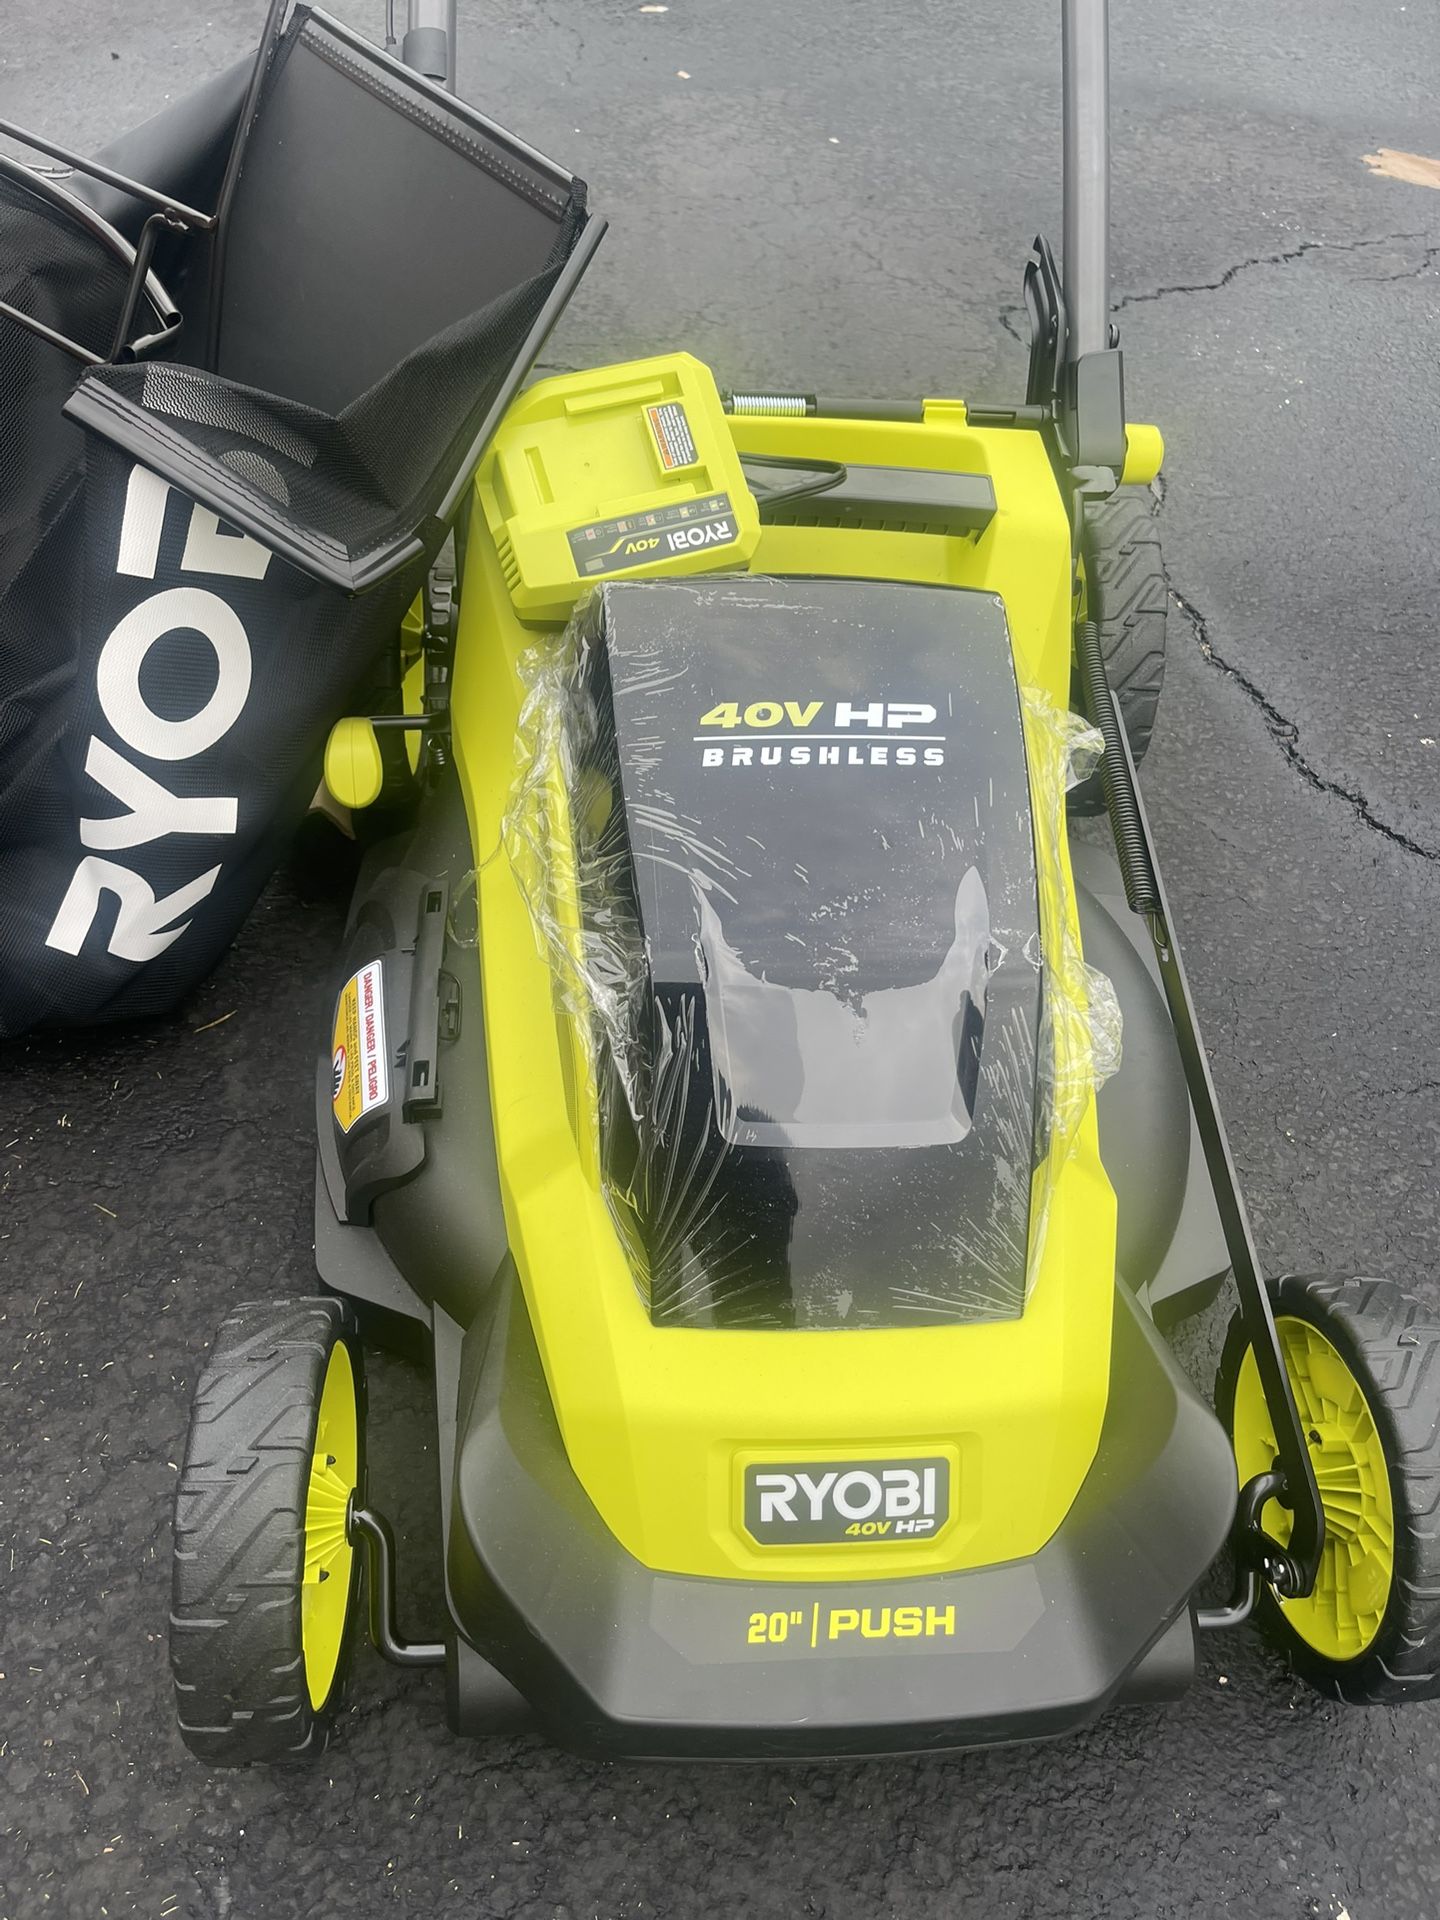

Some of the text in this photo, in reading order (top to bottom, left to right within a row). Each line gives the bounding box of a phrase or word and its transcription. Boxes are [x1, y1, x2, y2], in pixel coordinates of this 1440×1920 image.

[625, 521, 732, 555] RYOBI 40V
[700, 702, 937, 728] 40V HP
[702, 746, 945, 767] BRUSHLESS
[363, 972, 374, 1009] DANGER
[365, 1013, 376, 1053] DANGER
[367, 1059, 378, 1101] PELIGRO
[756, 1467, 936, 1522] RYOBI
[845, 1519, 935, 1536] 40V HP
[747, 1605, 956, 1644] 20" PUSH
